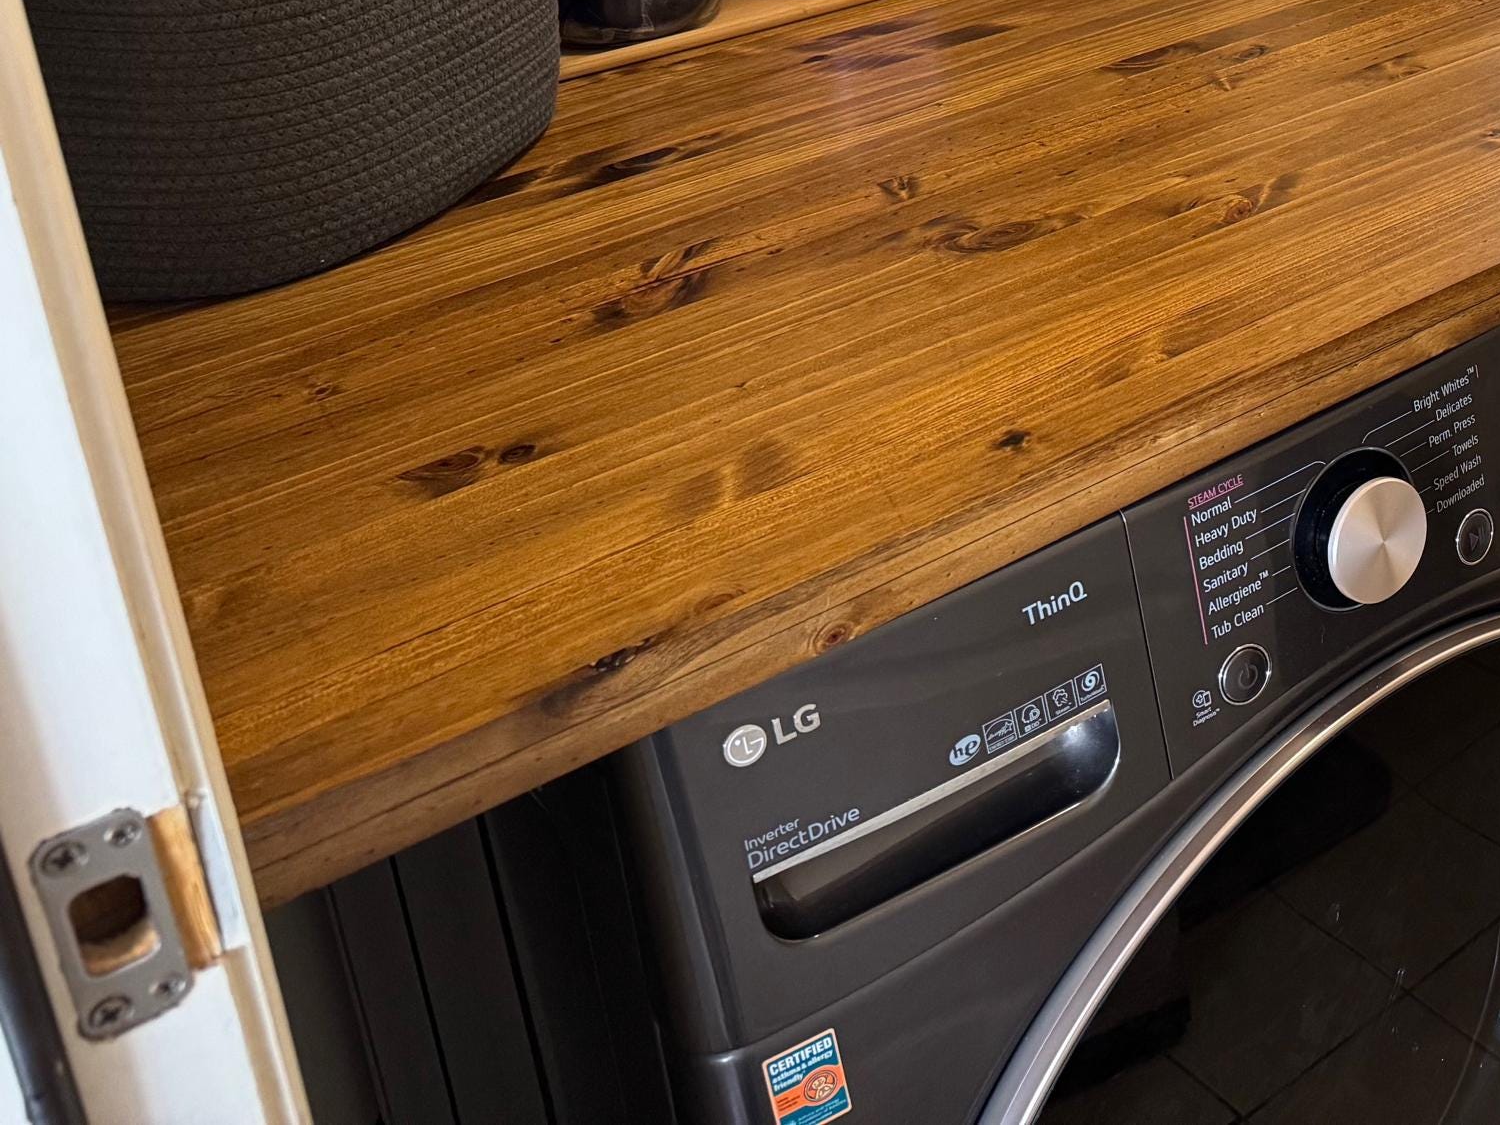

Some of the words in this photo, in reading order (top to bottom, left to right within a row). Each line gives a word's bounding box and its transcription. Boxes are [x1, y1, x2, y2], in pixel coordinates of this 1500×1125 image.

[1413, 390, 1441, 413] Bright
[1435, 393, 1473, 421] Delicates
[1453, 413, 1476, 434] Press
[1452, 433, 1479, 457] Towels
[1433, 466, 1459, 491] Speed
[1460, 454, 1482, 473] Wash
[1187, 487, 1217, 508] STEAM
[1217, 474, 1243, 494] CYCLE
[1436, 475, 1485, 513] Downloaded
[1191, 496, 1232, 527] Normal
[1195, 523, 1229, 548] Heavy
[1231, 508, 1257, 530] Duty
[1199, 540, 1244, 570] Bedding
[1203, 562, 1248, 593] Sanitary
[1022, 581, 1088, 626] ThinQ
[1211, 620, 1232, 639] Tub
[1233, 603, 1264, 627] Clean
[771, 703, 821, 746] LG
[744, 818, 800, 852] Inverter
[769, 1036, 832, 1076] CERTIFIED
